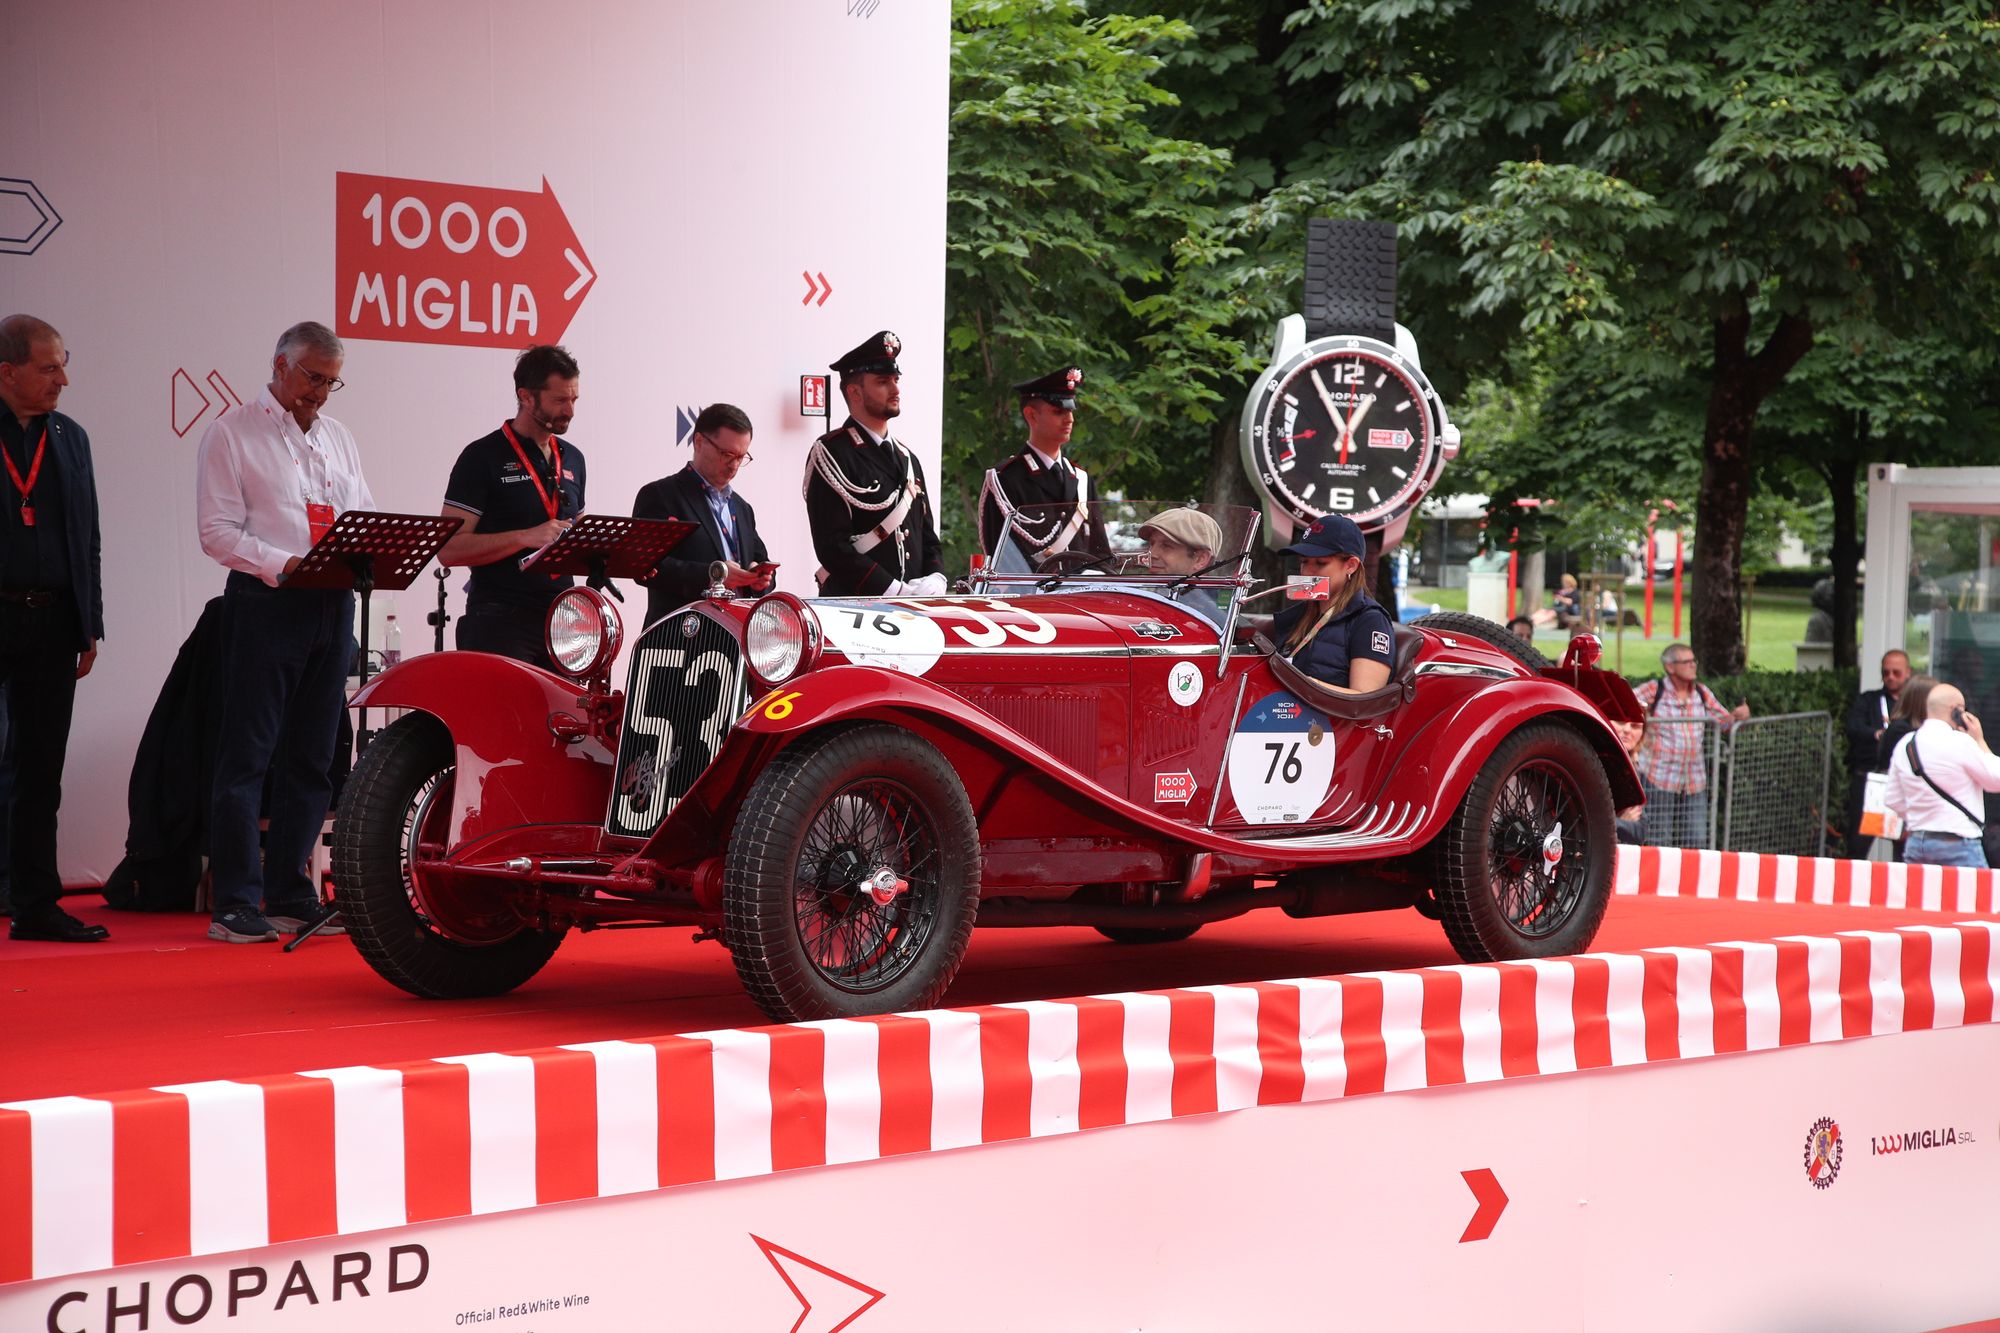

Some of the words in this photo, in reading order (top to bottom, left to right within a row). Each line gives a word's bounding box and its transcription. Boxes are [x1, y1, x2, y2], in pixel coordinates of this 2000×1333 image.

[362, 192, 528, 258] 1000
[349, 271, 538, 337] MIGLIA
[1267, 378, 1280, 392] 50
[1332, 363, 1366, 386] 12
[1253, 425, 1263, 438] 45
[1262, 471, 1274, 486] 40
[1418, 480, 1430, 492] 20
[1329, 487, 1355, 511] 6
[1292, 507, 1305, 518] 35
[839, 609, 901, 636] 76
[744, 690, 804, 720] 76
[617, 648, 735, 832] 53
[1264, 742, 1303, 784] 76
[1158, 788, 1187, 799] MIGLIA
[1160, 777, 1186, 787] 1000
[1958, 1131, 1976, 1144] SRL
[46, 1243, 430, 1333] CHOPARD
[455, 1308, 495, 1326] Official
[499, 1298, 560, 1319] Red&White
[563, 1294, 590, 1308] Wine
